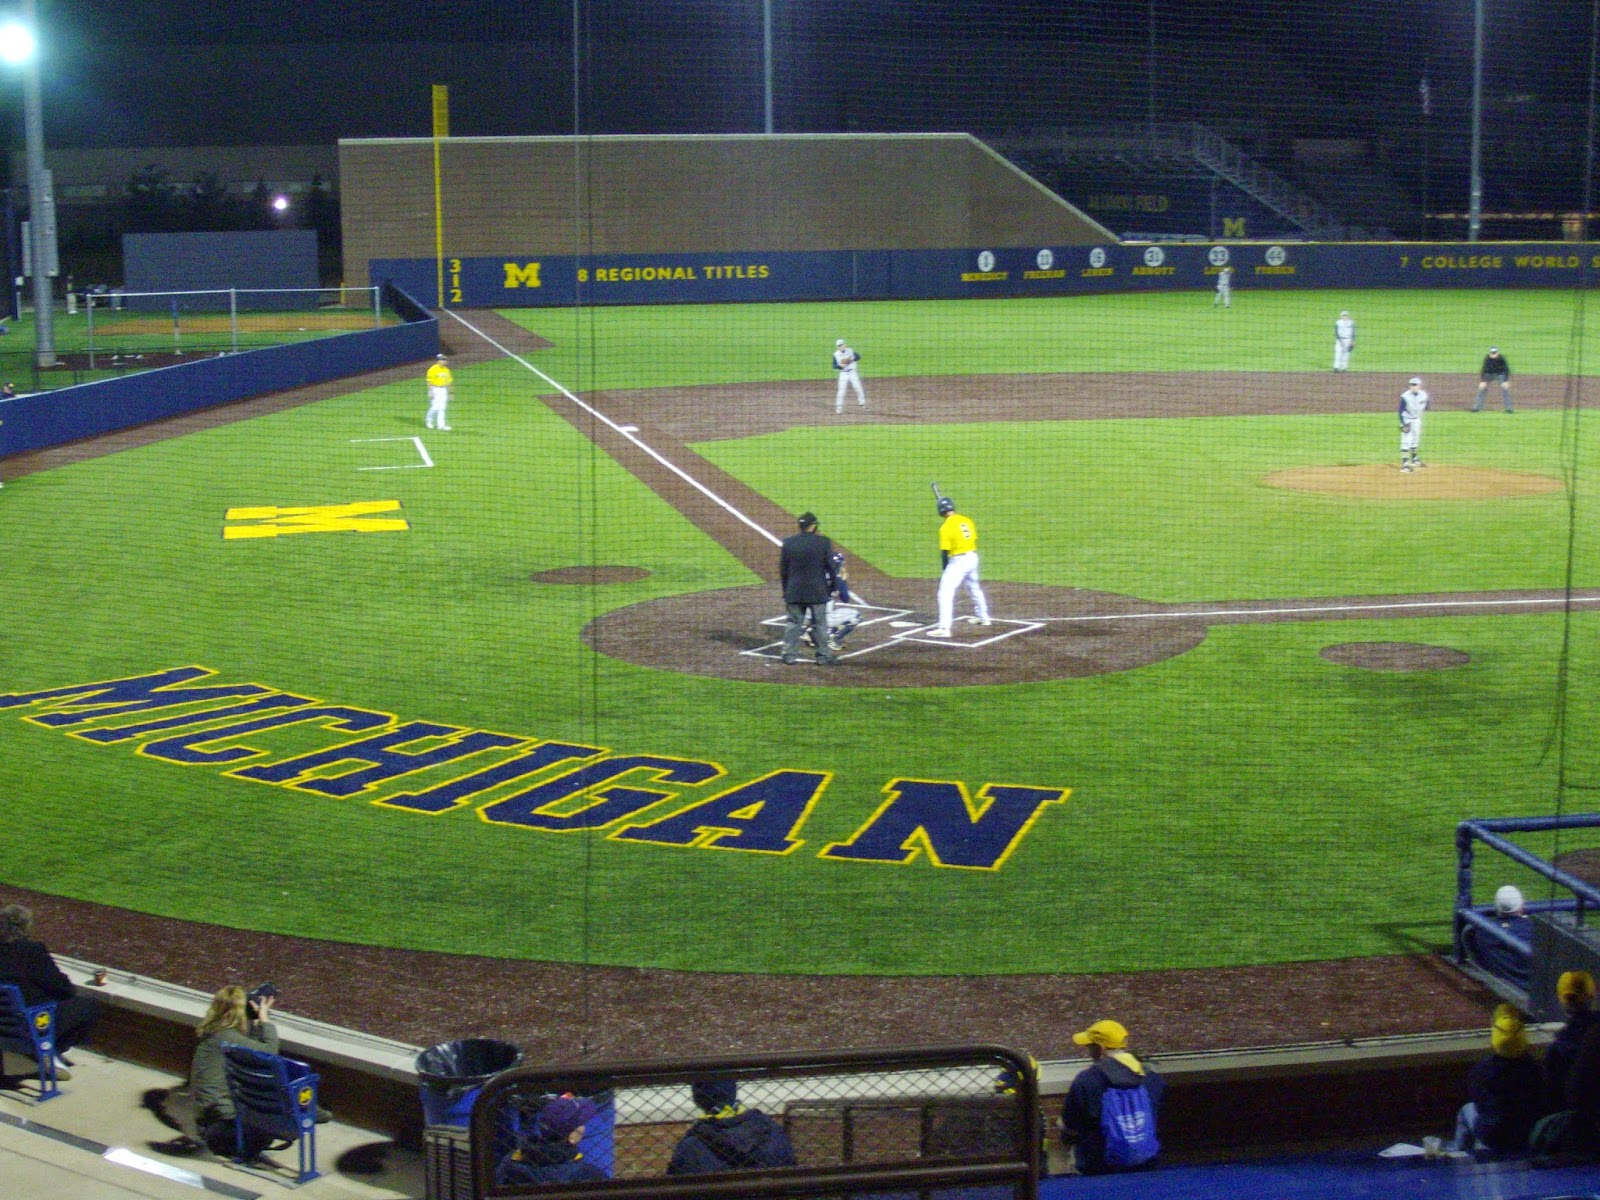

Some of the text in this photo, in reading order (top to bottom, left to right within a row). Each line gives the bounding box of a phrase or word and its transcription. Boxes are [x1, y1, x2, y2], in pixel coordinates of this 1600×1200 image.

[1222, 217, 1247, 238] M
[1400, 256, 1409, 268] 7
[1421, 255, 1503, 268] COLLEGE
[1514, 255, 1581, 268] WORLD
[503, 262, 541, 288] M
[577, 265, 770, 282] 8 REGIONAL TITLES
[0, 665, 1072, 871] MICHIGAN
